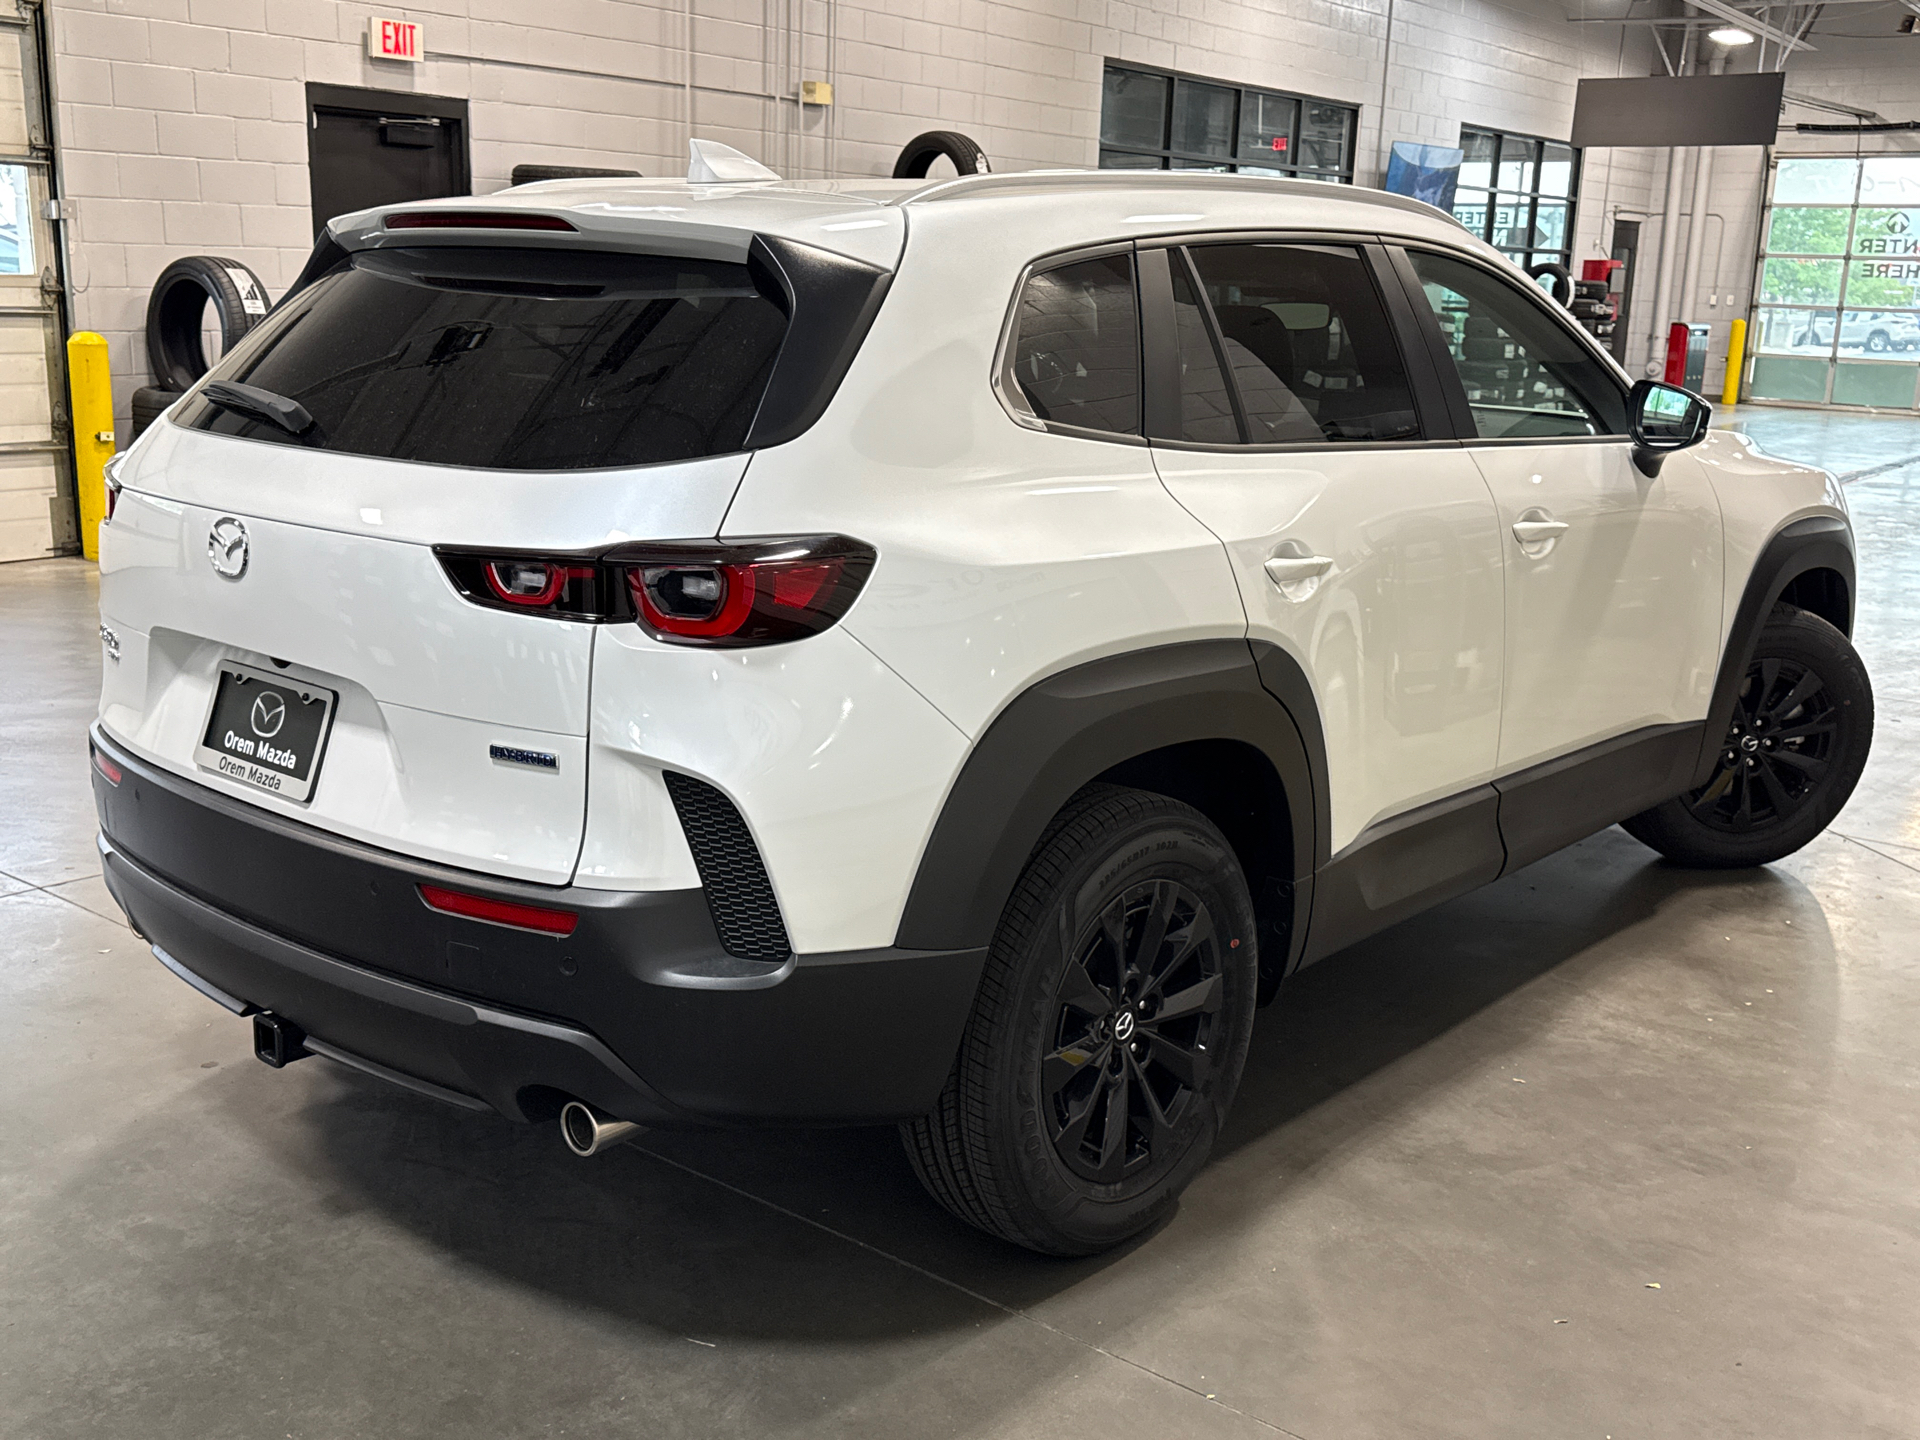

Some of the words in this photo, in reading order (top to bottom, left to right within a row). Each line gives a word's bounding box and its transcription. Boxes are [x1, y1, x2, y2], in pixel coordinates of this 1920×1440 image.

[382, 21, 416, 57] EXIT
[224, 730, 255, 756] Orem
[256, 740, 297, 770] Mazda
[494, 747, 553, 767] HYBRID
[219, 756, 246, 778] Orem
[247, 765, 282, 790] Mazda
